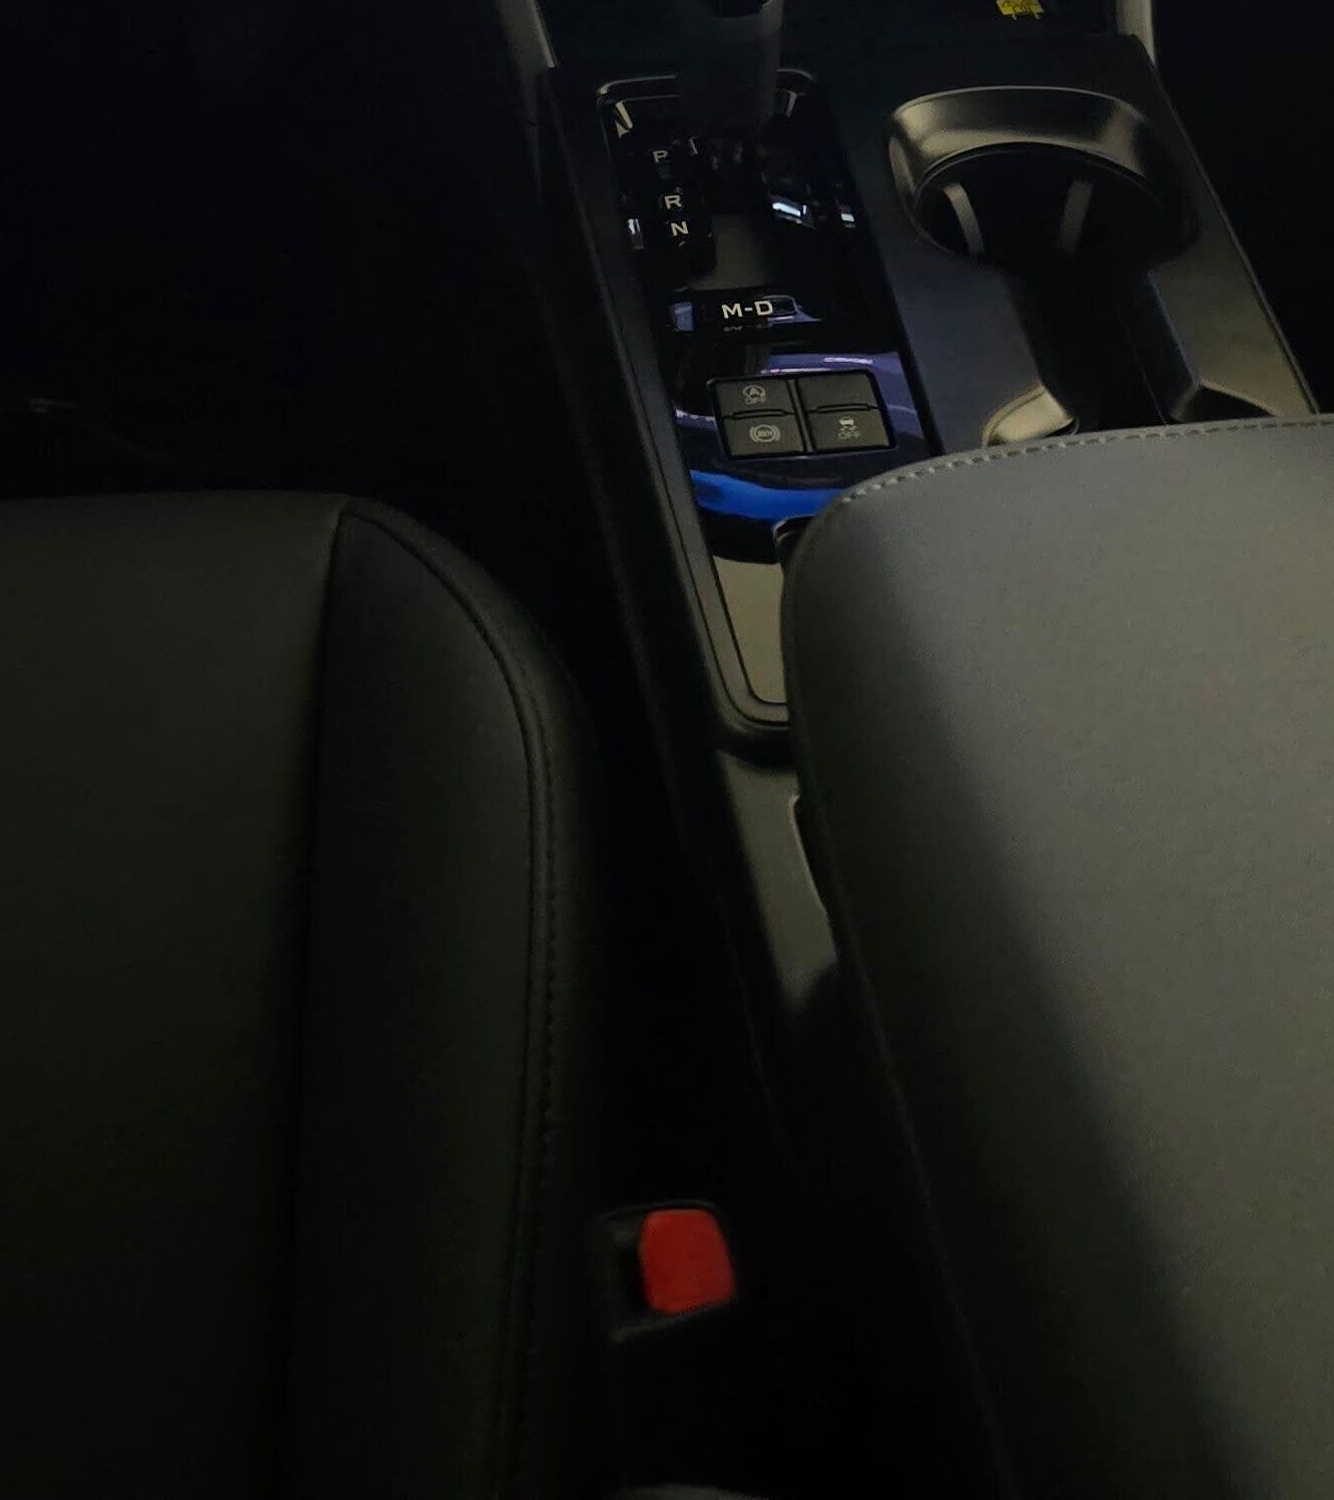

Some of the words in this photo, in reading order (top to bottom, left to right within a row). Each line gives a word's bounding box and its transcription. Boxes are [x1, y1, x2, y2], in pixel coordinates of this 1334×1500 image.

[652, 149, 669, 164] P
[663, 194, 683, 210] R
[670, 220, 689, 238] N
[720, 299, 774, 320] M-D
